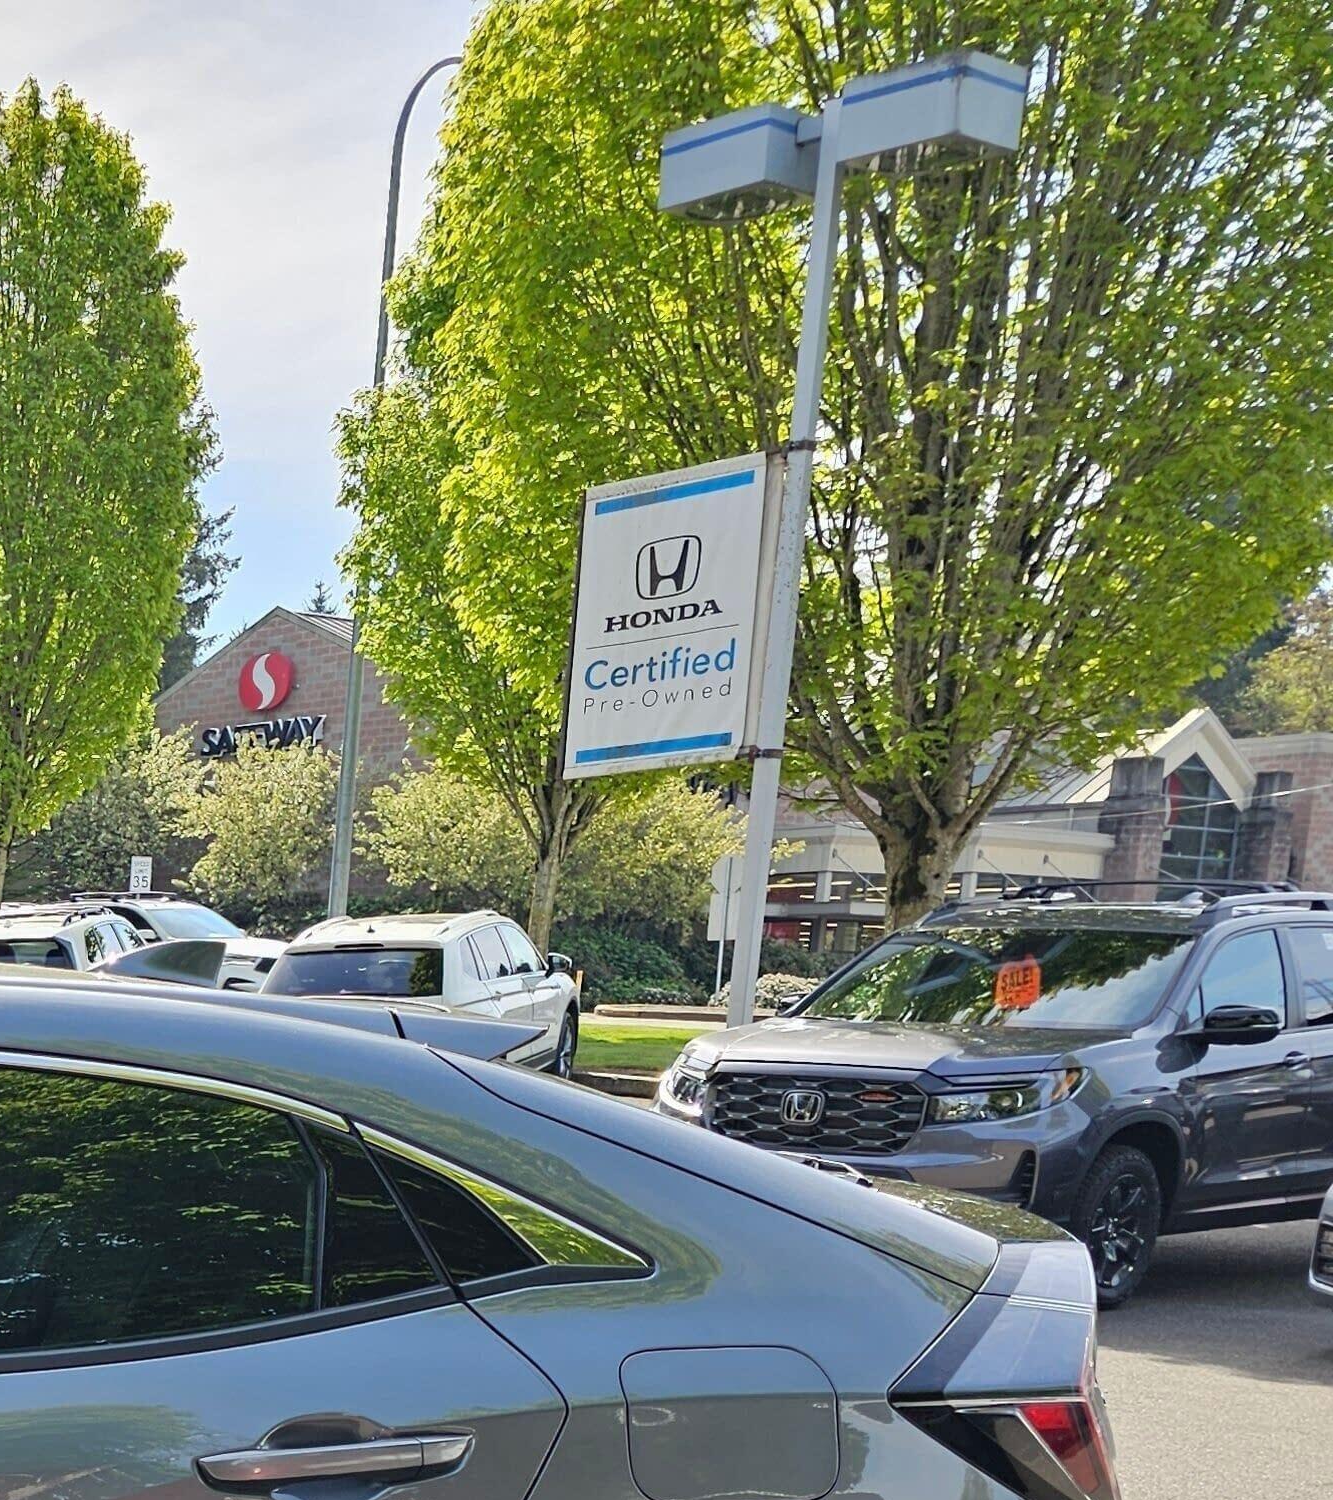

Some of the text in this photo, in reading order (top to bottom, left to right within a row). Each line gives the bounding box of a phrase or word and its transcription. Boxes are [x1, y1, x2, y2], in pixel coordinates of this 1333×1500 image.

[604, 599, 723, 633] HONDA
[584, 638, 736, 691] Certified
[583, 677, 732, 715] Pre-Owned
[133, 875, 149, 888] 35
